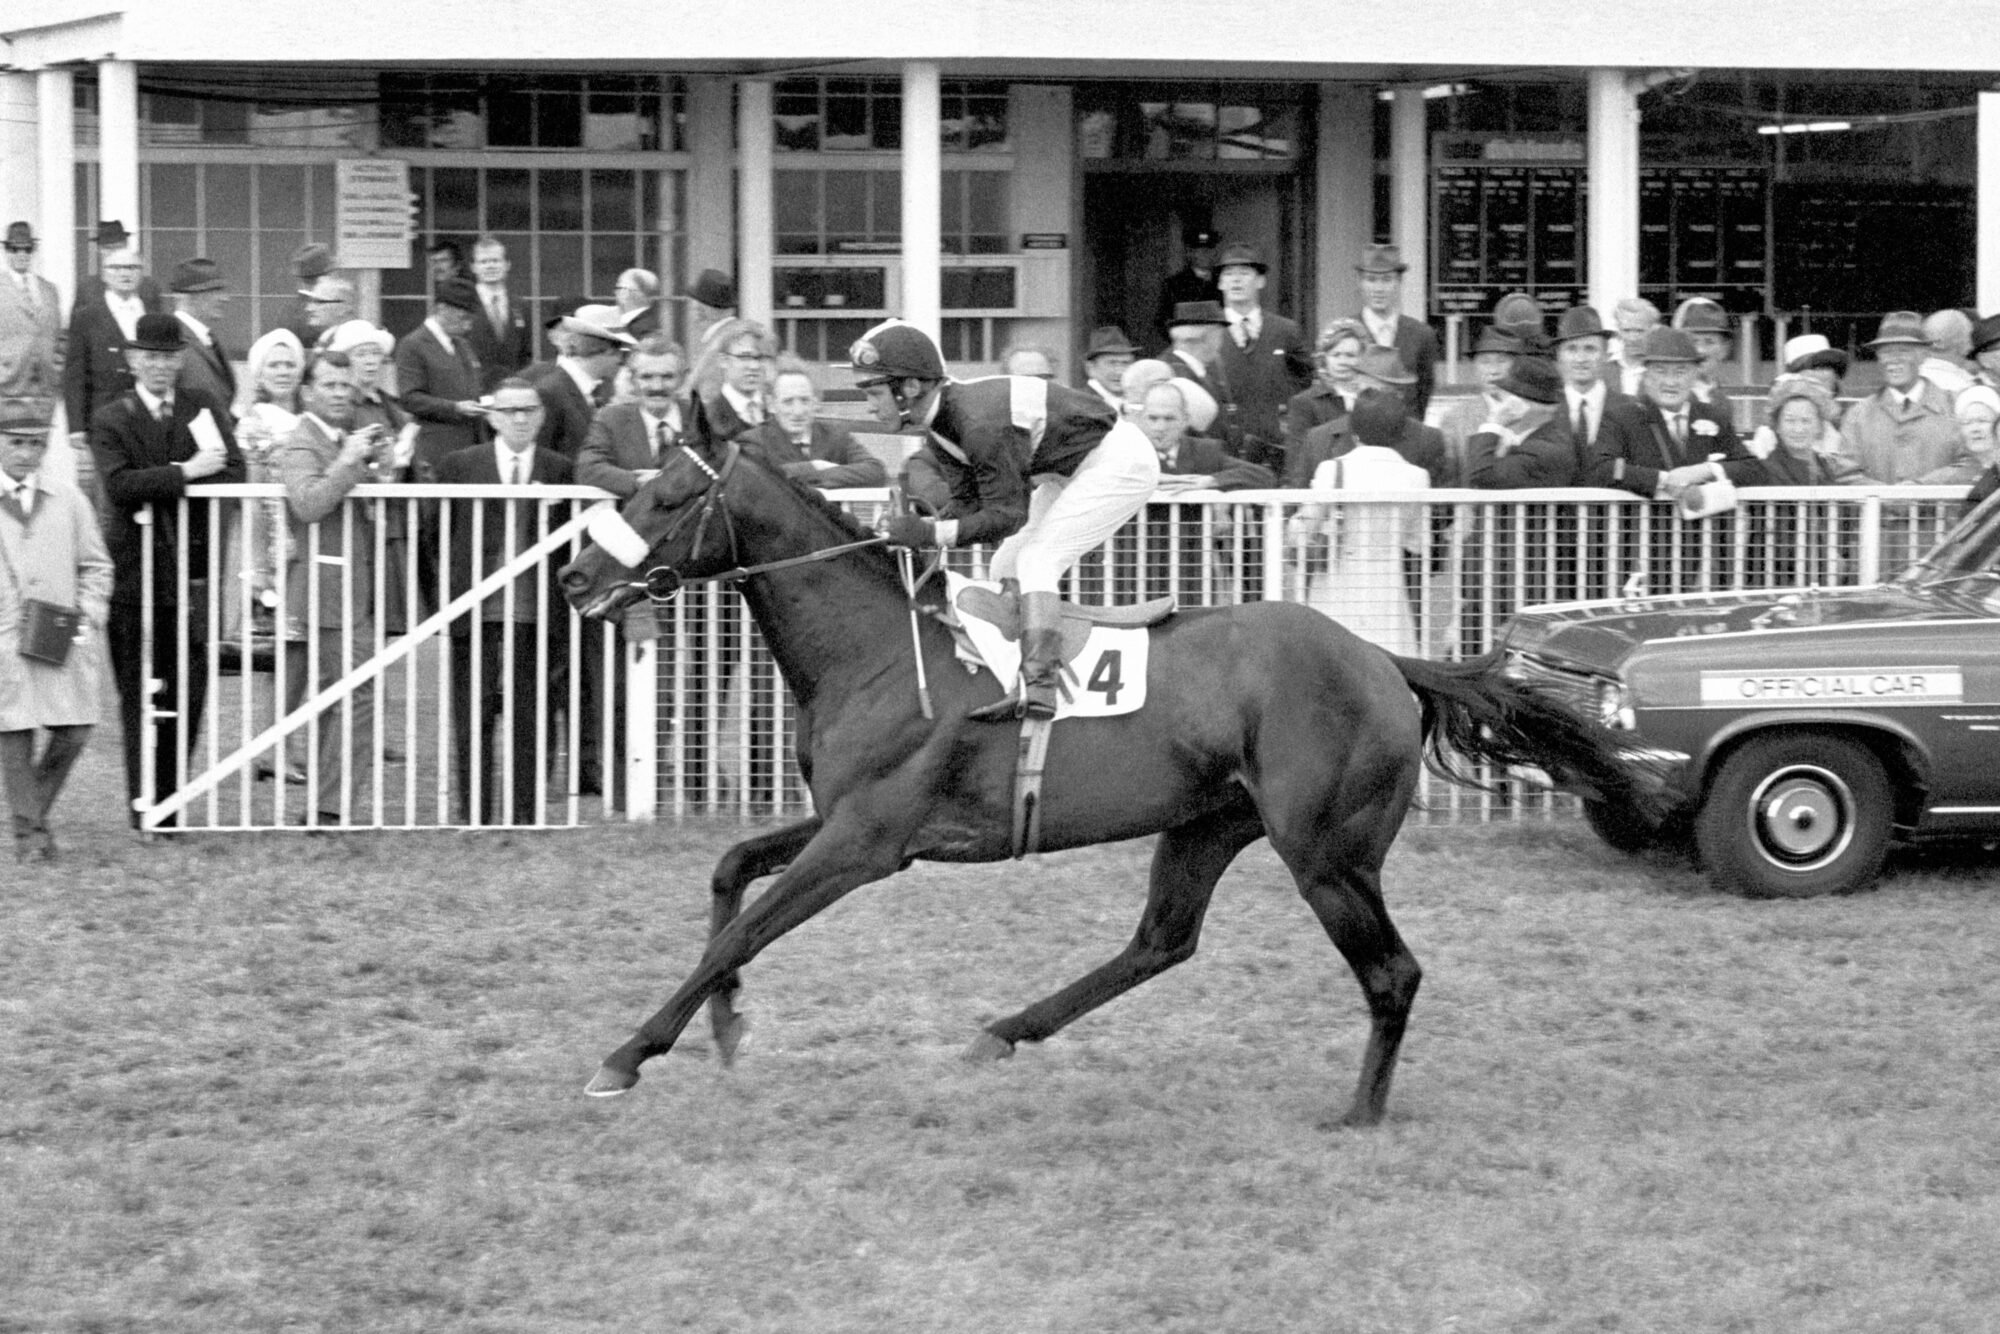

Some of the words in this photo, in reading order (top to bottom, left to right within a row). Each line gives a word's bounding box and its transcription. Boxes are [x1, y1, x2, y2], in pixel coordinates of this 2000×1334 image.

[1087, 649, 1124, 706] 4
[1739, 677, 1863, 698] OFFICIAL
[1869, 675, 1928, 695] CAR
